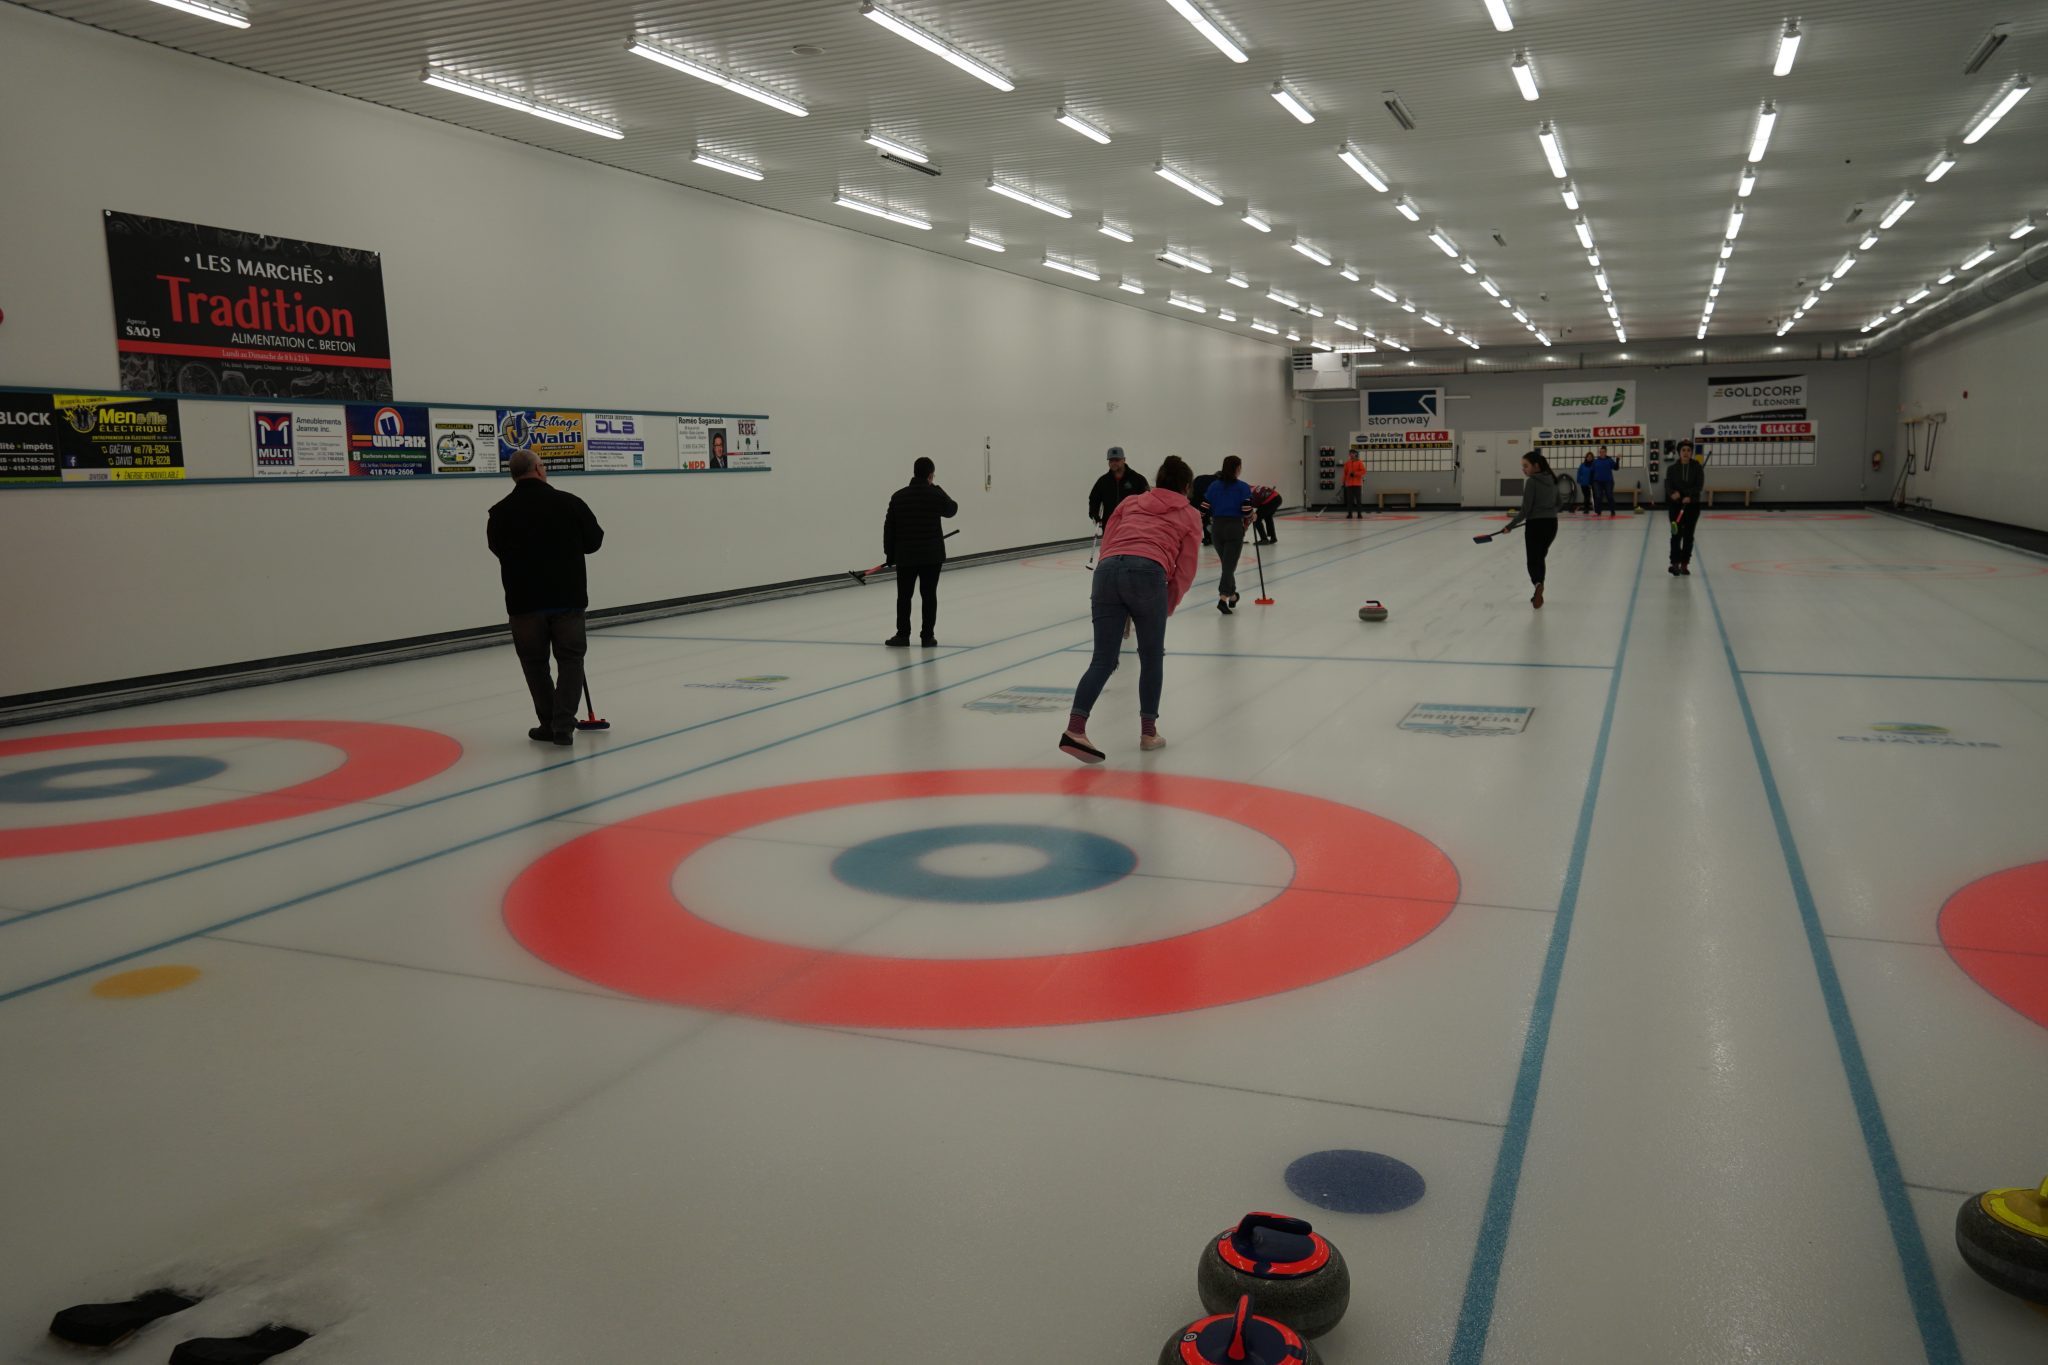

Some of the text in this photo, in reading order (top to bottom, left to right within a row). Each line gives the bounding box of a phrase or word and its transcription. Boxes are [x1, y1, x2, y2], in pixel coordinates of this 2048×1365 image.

[196, 253, 323, 284] LES MARCHÉS
[156, 274, 354, 338] Tradition
[126, 326, 150, 338] SAQ
[231, 332, 356, 352] ALIMENTATION C. BRETON
[1724, 386, 1802, 397] GOLDCORP
[1552, 396, 1608, 406] Barrette
[0, 412, 51, 426] BLOCK
[100, 408, 136, 424] Men
[1368, 416, 1430, 427] stornoway
[479, 425, 494, 433] PRO
[1598, 428, 1627, 436] GLACE
[1766, 425, 1797, 433] GLACE
[373, 436, 426, 448] UNIPRIX
[530, 432, 581, 444] Waldi
[23, 442, 54, 451] impôts
[258, 448, 292, 458] MULTI
[688, 461, 705, 469] NPD
[1411, 713, 1522, 723] PROVINCIAL
